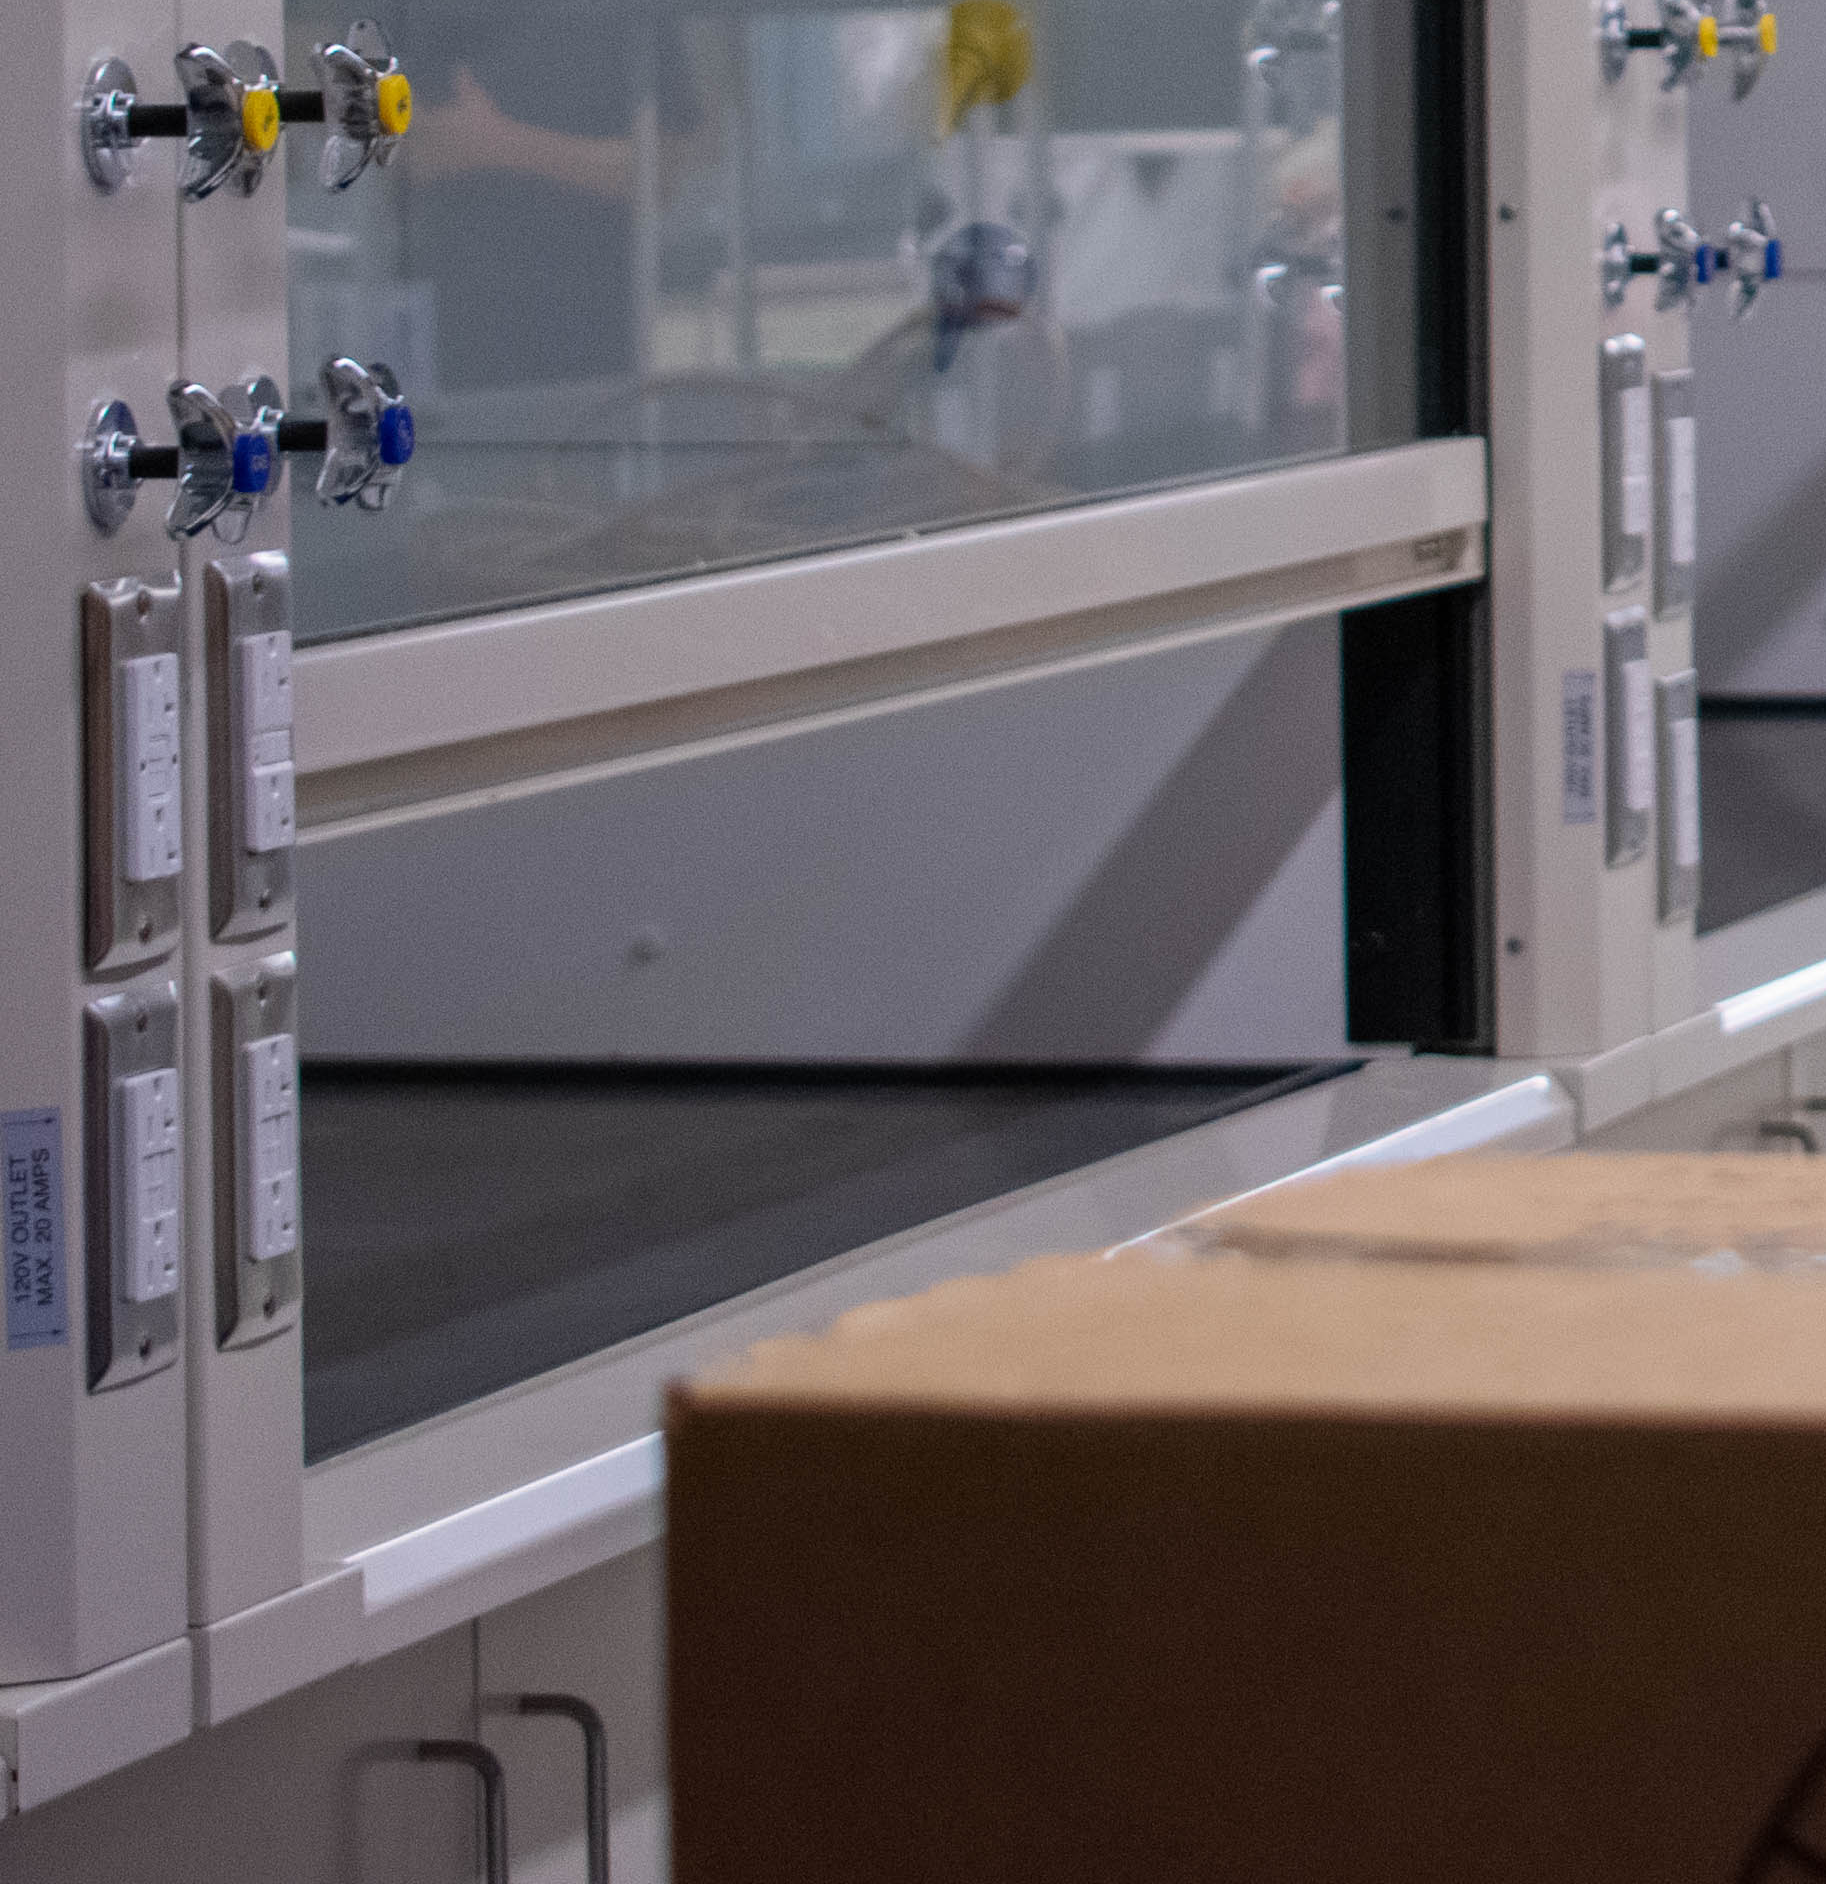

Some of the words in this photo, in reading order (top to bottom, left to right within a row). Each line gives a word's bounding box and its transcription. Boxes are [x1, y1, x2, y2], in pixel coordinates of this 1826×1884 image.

[9, 1155, 30, 1244] OUTLET
[32, 1148, 51, 1212] AMPS
[35, 1218, 53, 1243] 20
[12, 1250, 32, 1304] 120V
